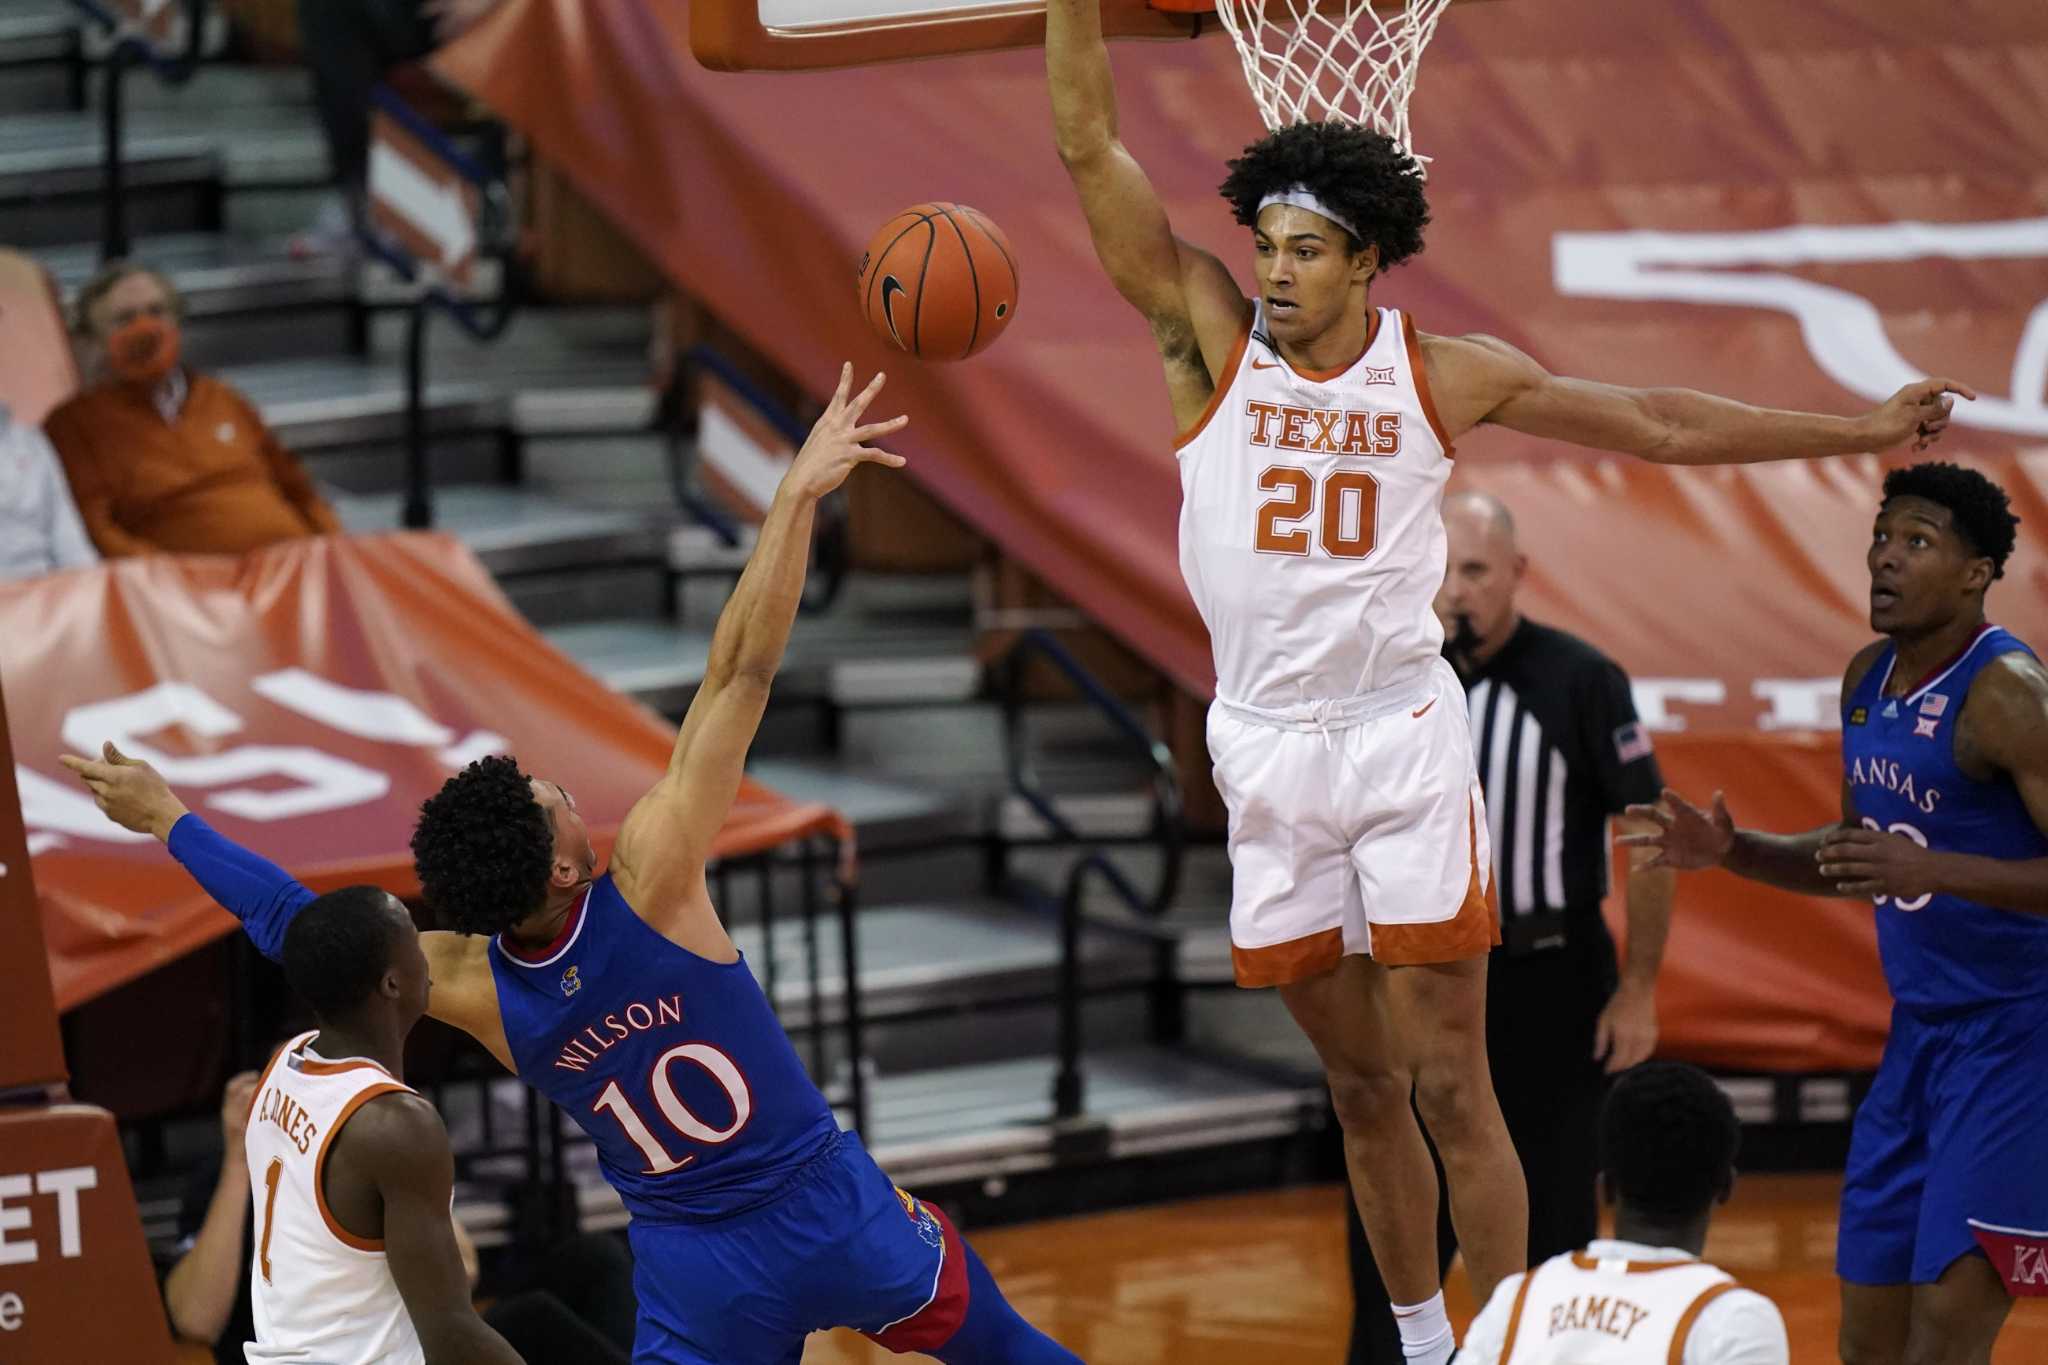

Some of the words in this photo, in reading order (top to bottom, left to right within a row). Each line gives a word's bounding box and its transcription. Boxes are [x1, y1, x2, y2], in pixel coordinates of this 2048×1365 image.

[1246, 399, 1401, 457] TEXAS
[1254, 465, 1380, 560] 20
[1849, 757, 1941, 813] ANSAS
[554, 995, 681, 1073] WILSON
[593, 1041, 751, 1175] 10
[261, 1155, 284, 1288] 1
[1548, 1295, 1650, 1341] RAMEY
